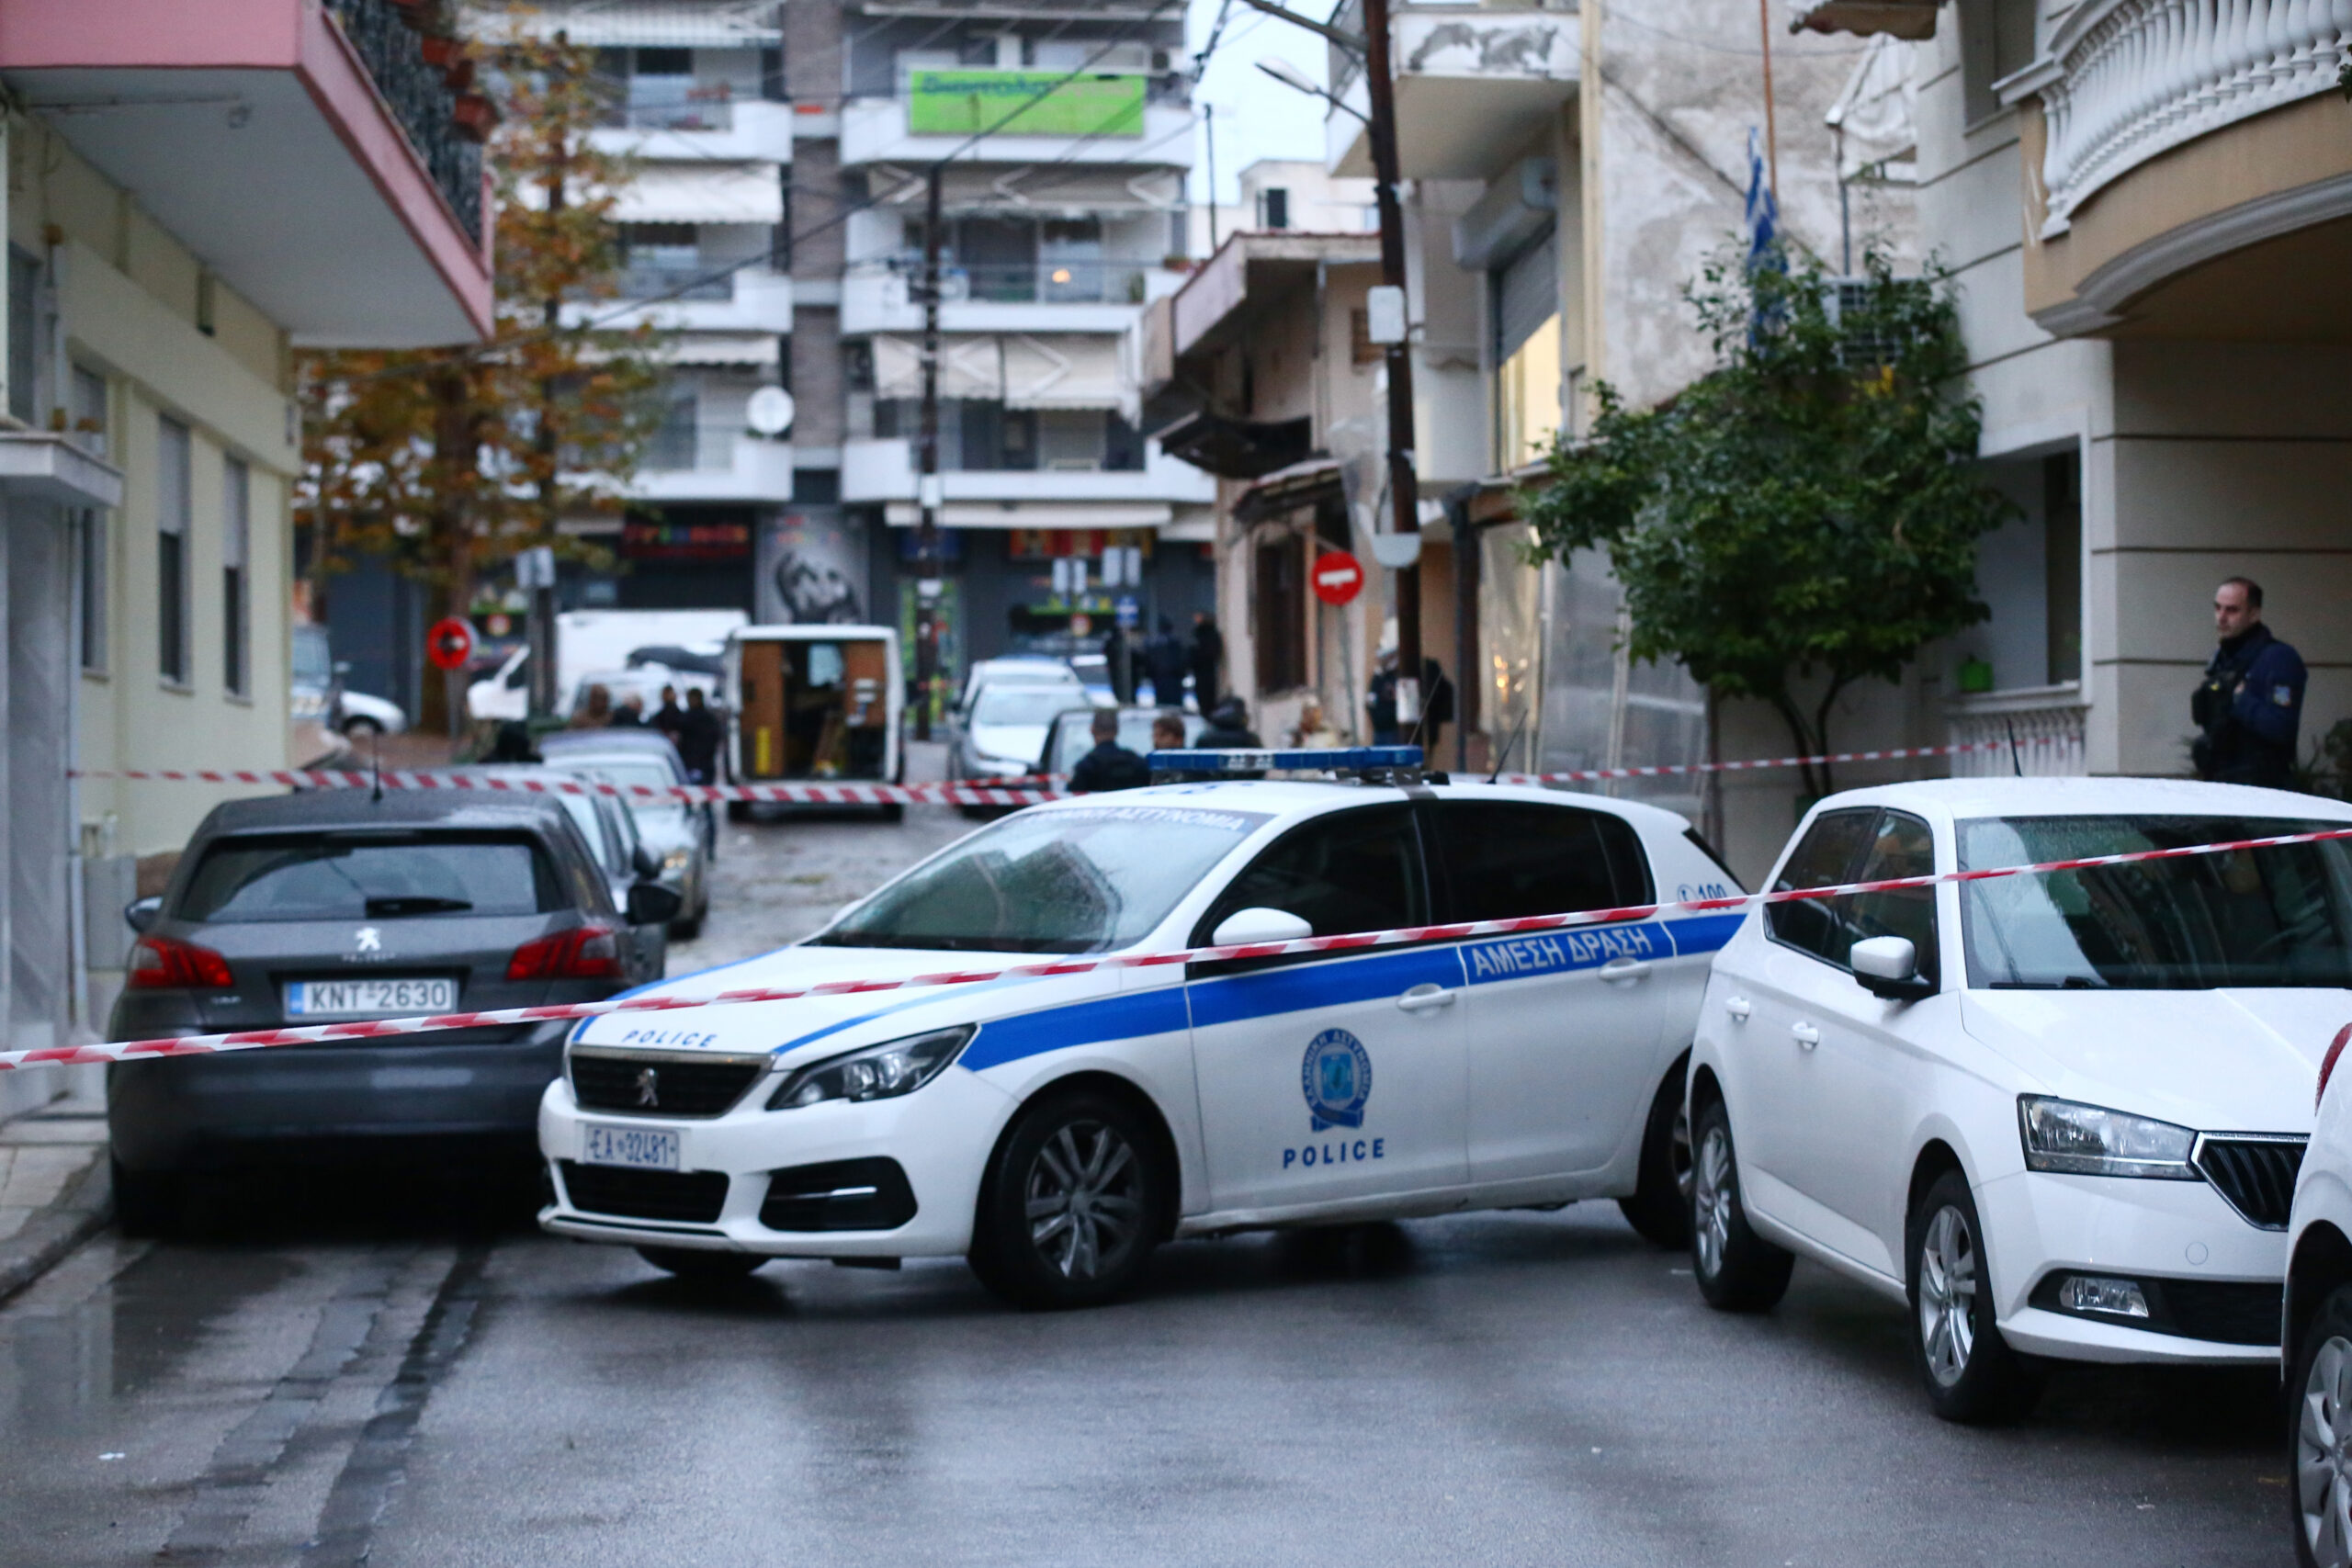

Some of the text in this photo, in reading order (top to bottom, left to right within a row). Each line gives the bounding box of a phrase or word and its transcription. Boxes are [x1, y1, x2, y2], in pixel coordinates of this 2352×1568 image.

[1471, 927, 1653, 976] ΑΜΕΣΗ ΔΡΑΣΗ
[622, 1030, 718, 1047] POLICE
[1283, 1138, 1385, 1169] POLICE
